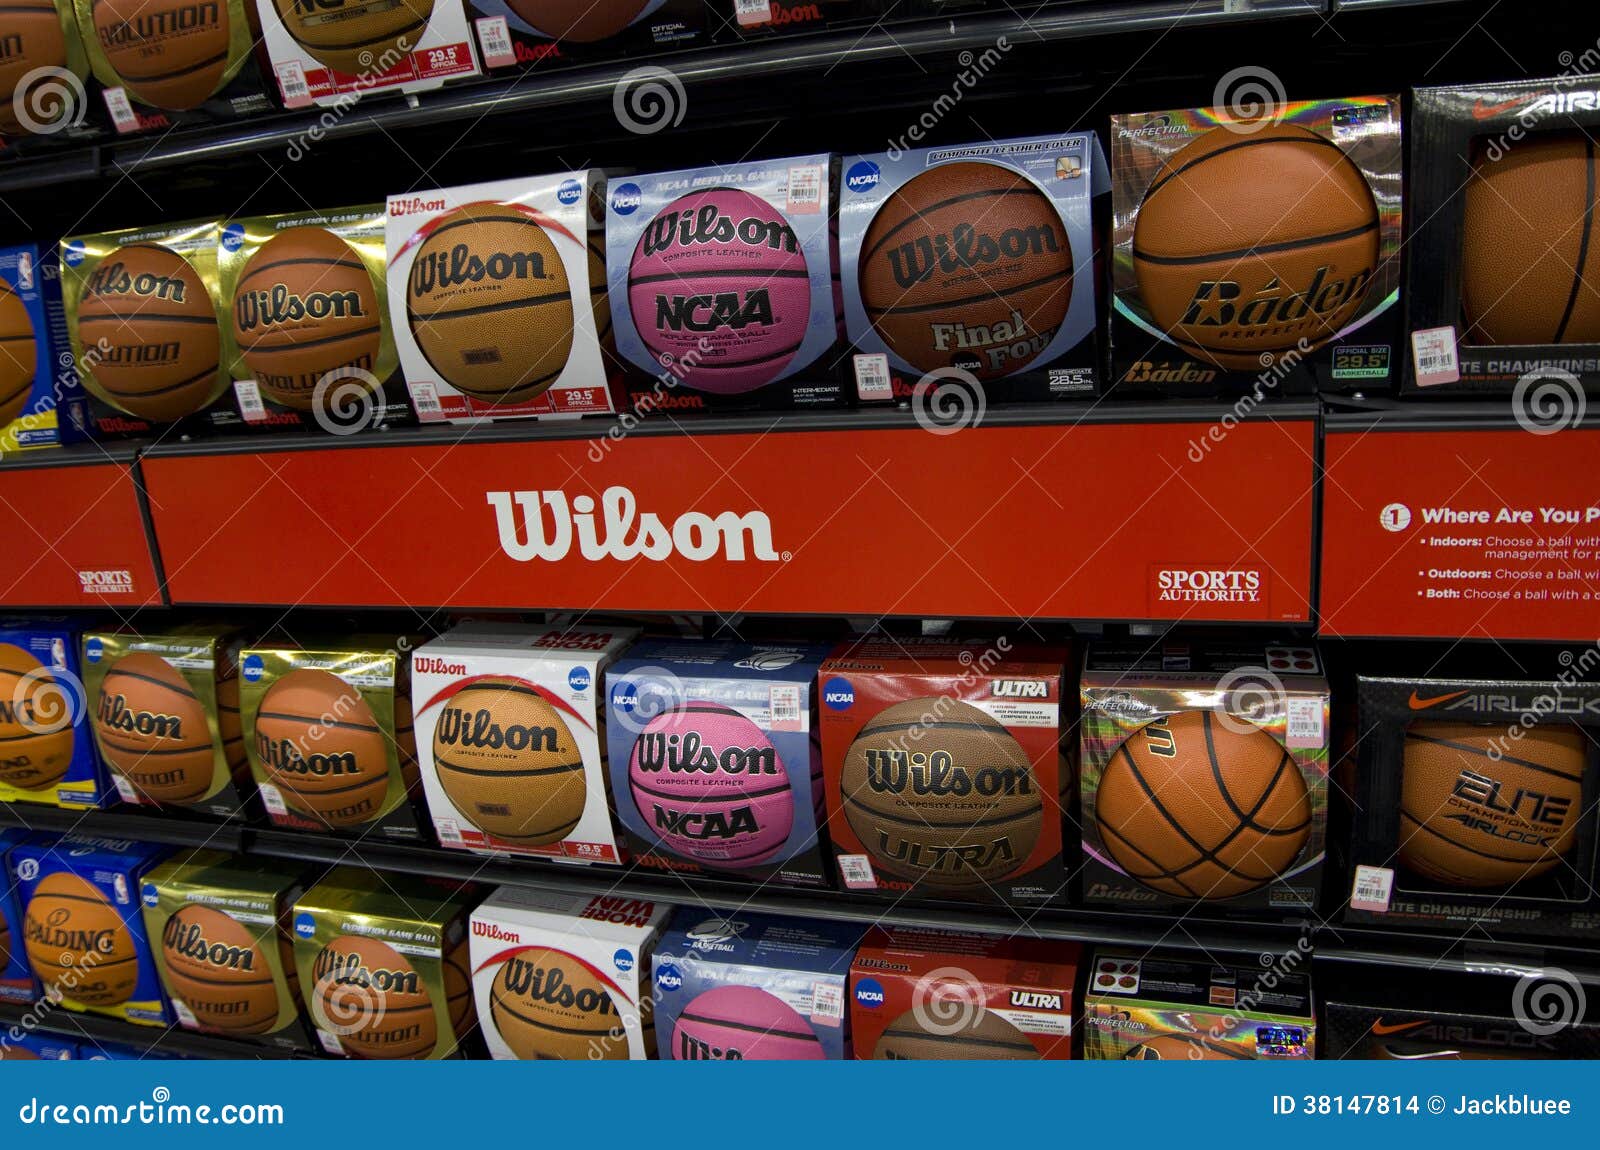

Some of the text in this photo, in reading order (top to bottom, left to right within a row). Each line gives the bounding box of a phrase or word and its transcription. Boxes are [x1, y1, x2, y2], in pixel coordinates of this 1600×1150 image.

[1118, 125, 1188, 138] PERFECTION
[932, 139, 1082, 160] COMPOSITE LEATHER COVER
[849, 175, 879, 186] NCAA
[559, 189, 583, 200] NCAA
[389, 198, 446, 217] Wilson
[614, 197, 641, 209] NCAA
[643, 205, 799, 256] Wilson
[662, 249, 762, 263] COMPOSITE LEATHER
[887, 223, 1059, 289] Wilson
[413, 243, 548, 297] Wilson
[237, 283, 364, 332] Wilson
[655, 288, 774, 332] NCAA
[930, 309, 1028, 351] Final
[793, 386, 840, 394] INTERMEDIATE
[486, 486, 780, 561] Wilson
[1421, 508, 1490, 524] Where
[1495, 508, 1533, 523] Are
[1539, 508, 1580, 523] You
[1430, 536, 1482, 547] Indoors:
[1486, 536, 1533, 547] Choose
[1537, 539, 1545, 547] a
[1548, 536, 1571, 547] ball
[1484, 549, 1591, 562] management for
[79, 571, 132, 585] SPORTS
[1158, 570, 1260, 590] SPORTS
[1428, 569, 1491, 579] Outdoors:
[1495, 569, 1542, 580] Choose
[1557, 569, 1581, 580] ball
[83, 585, 134, 593] AUTHORITY
[1426, 589, 1591, 600] Both: Choose a ball with a
[415, 657, 467, 675] Wilson
[569, 677, 591, 687] NCAA
[992, 680, 1048, 697] ULTRA
[613, 696, 638, 705] NCAA
[826, 693, 854, 703] NCAA
[1084, 701, 1152, 713] PERFECTION
[438, 708, 559, 753] Wilson
[638, 731, 778, 775] Wilson
[865, 750, 1033, 797] Wilson
[656, 778, 699, 786] COMPOSITE
[896, 800, 999, 809] COMPOSITE LEATHER
[1451, 770, 1572, 826] ELITE
[653, 804, 761, 840] NCAA
[1448, 799, 1561, 834] CHAMPIONSHIP
[1441, 814, 1560, 848] AIRLOCK
[876, 828, 1018, 872] ULTRA
[588, 895, 655, 917] WIN
[1420, 904, 1543, 920] CHAMPIONSHIP
[578, 908, 650, 928] MORE
[342, 922, 436, 943] EVOLUTION GAME BALL
[472, 921, 520, 944] Wilson
[691, 941, 734, 952] BASKETBALL
[616, 957, 633, 967] NCAA
[858, 958, 911, 972] Wilson
[316, 948, 419, 994] Wilson
[658, 975, 682, 986] NCAA
[858, 991, 883, 1002] NCAA
[1012, 991, 1061, 1010] ULTRA
[1088, 1017, 1146, 1030] PERFECTION
